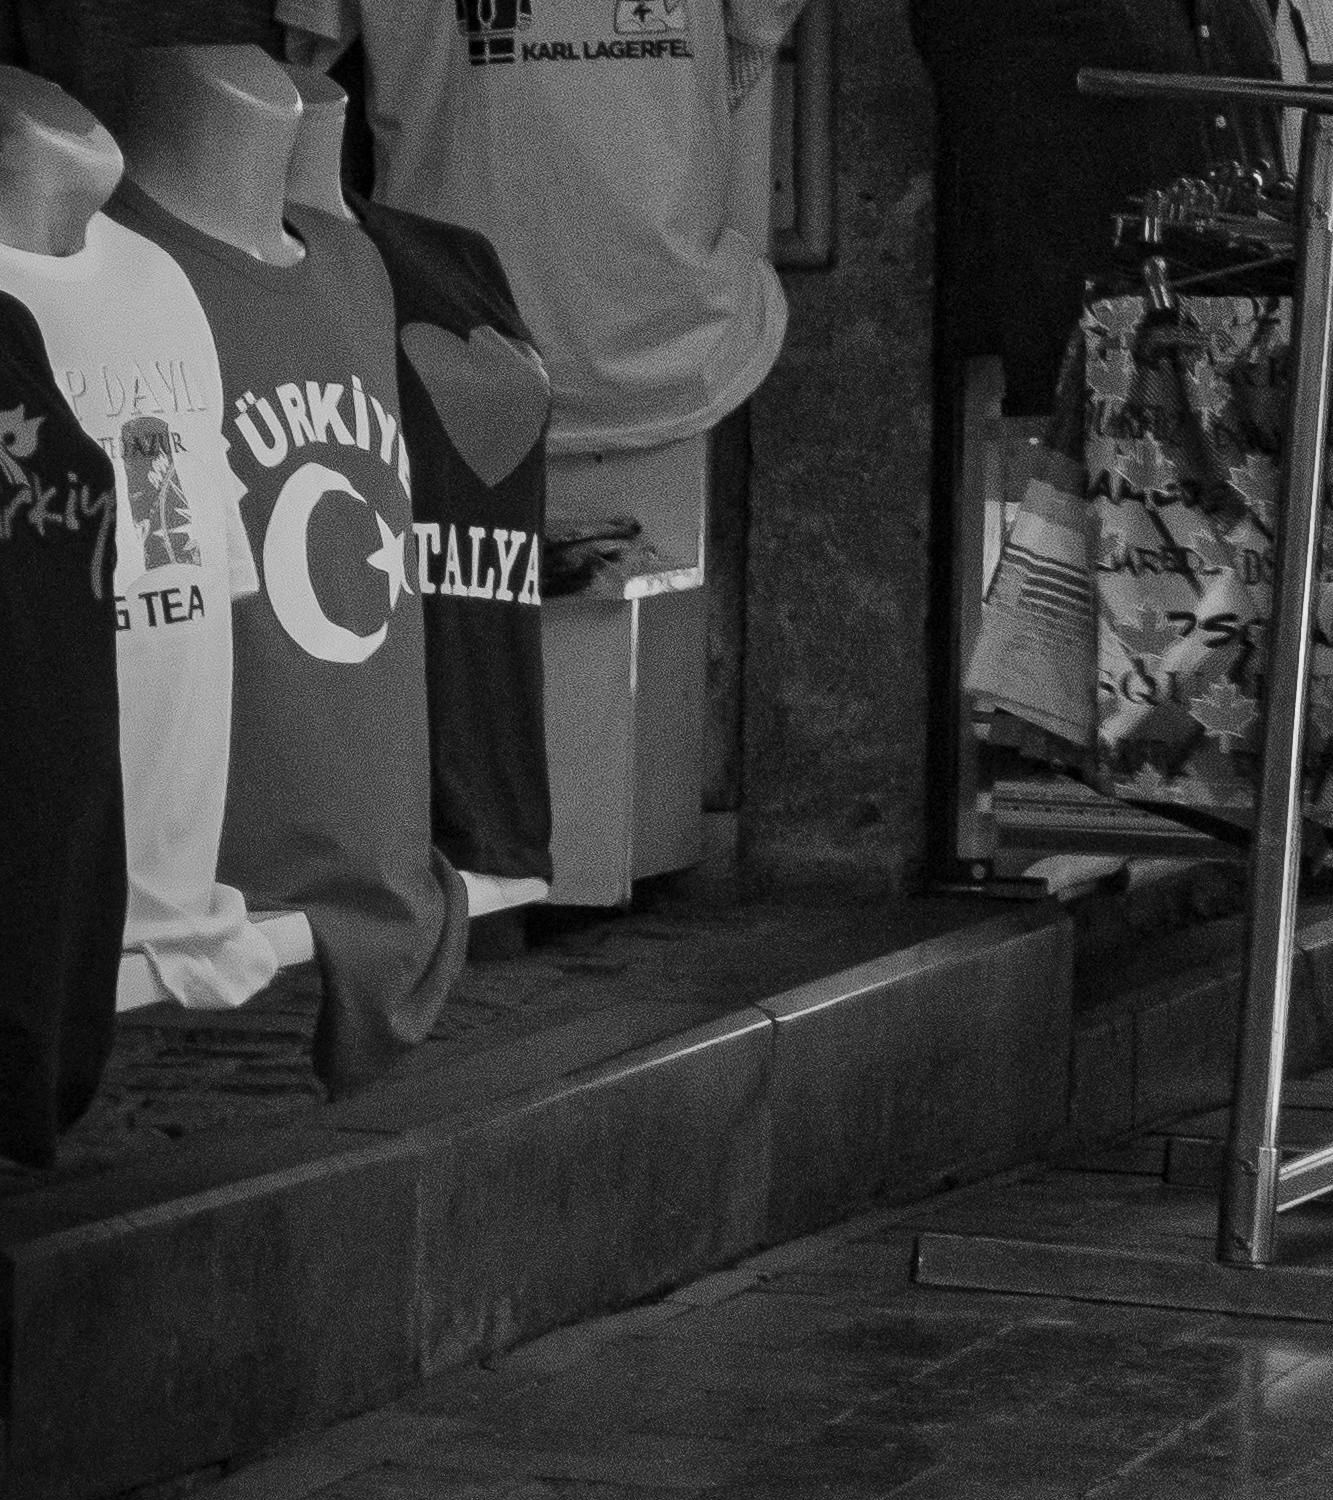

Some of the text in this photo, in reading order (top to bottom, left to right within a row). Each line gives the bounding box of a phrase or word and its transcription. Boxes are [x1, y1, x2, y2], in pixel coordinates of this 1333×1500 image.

[522, 41, 580, 62] KARL
[412, 522, 542, 606] TALYA
[138, 584, 205, 629] TEA
